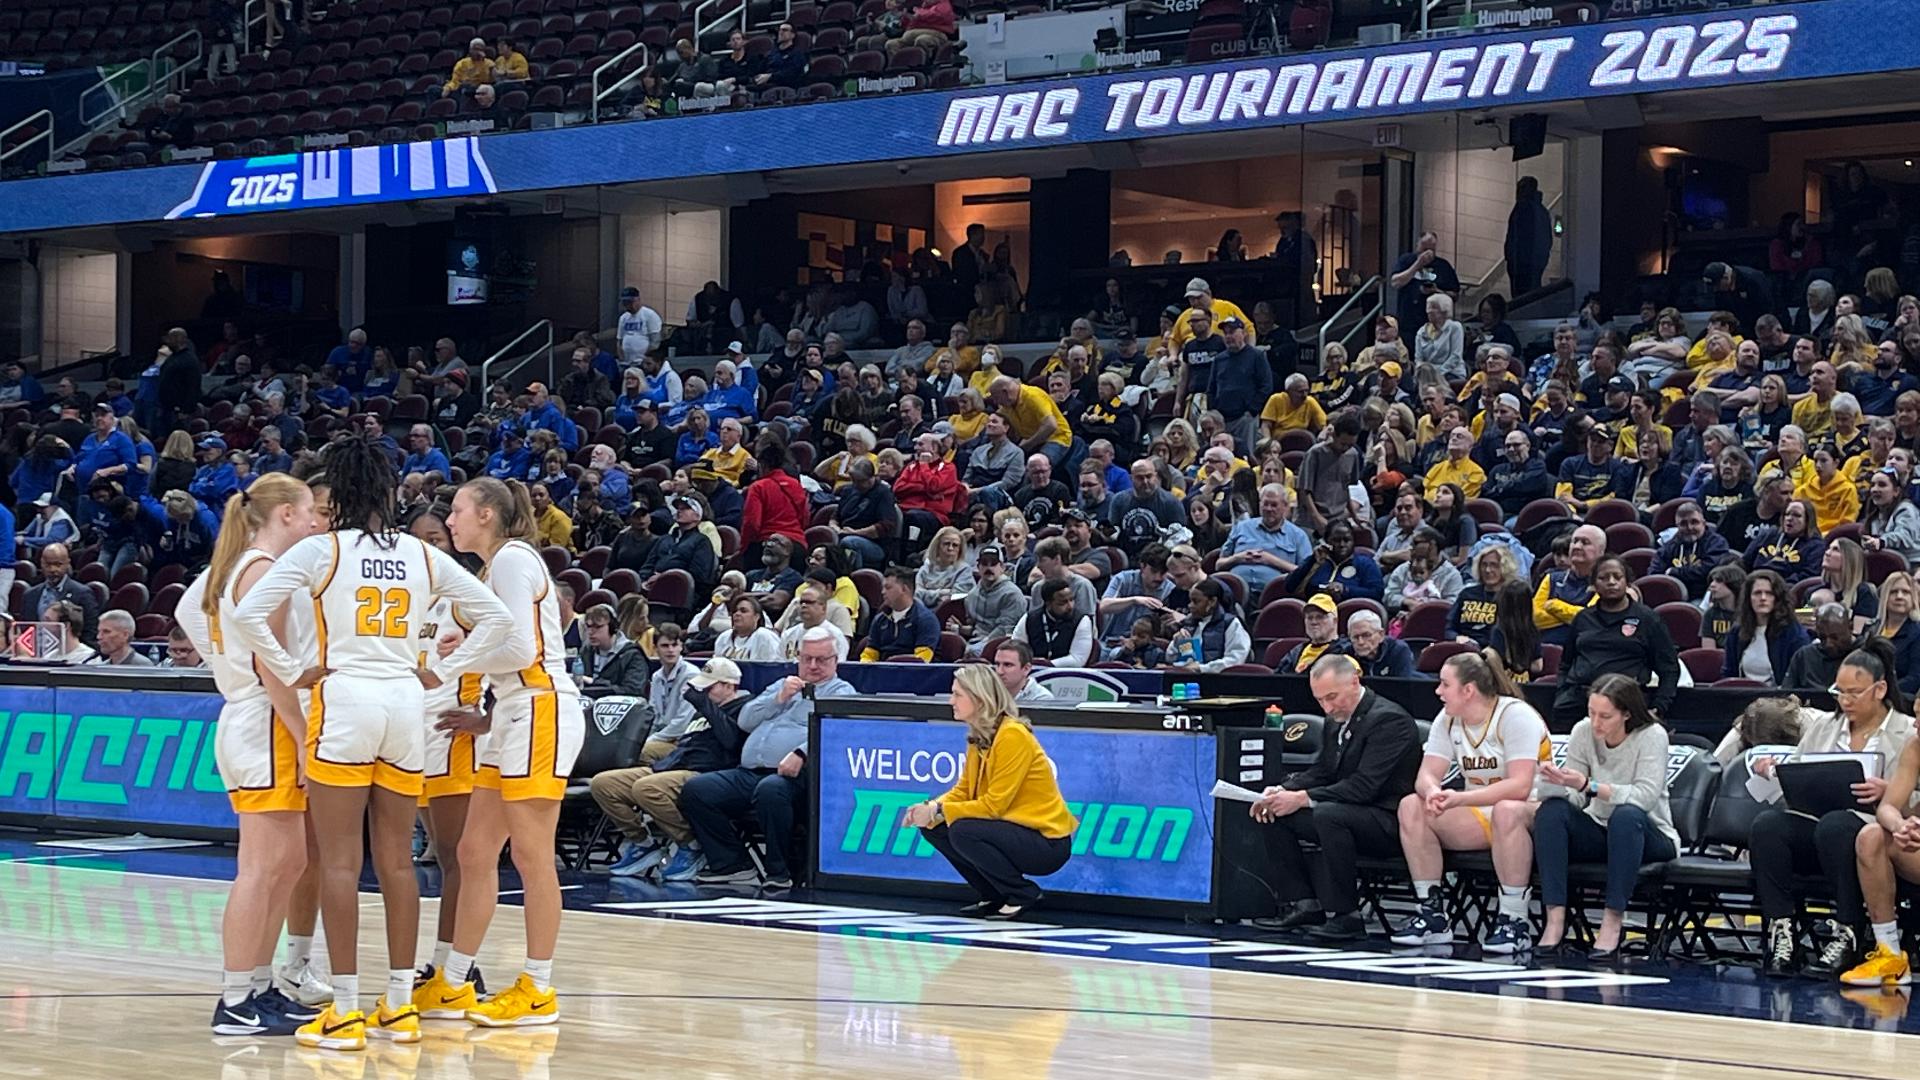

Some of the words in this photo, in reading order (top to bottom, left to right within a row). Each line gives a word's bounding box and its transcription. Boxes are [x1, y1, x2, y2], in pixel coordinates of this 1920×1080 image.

[1477, 7, 1553, 26] Huntington
[1098, 48, 1161, 69] Huntington
[1211, 40, 1247, 55] CLUB
[937, 88, 1081, 147] MAC
[1105, 36, 1574, 133] TOURNAMENT
[1589, 15, 1797, 88] 2025
[227, 173, 297, 207] 2025
[361, 558, 406, 580] GOSS
[355, 586, 411, 638] 22
[1461, 600, 1497, 612] TOLED
[598, 703, 628, 715] MAC
[847, 747, 967, 784] WELCO
[840, 788, 1194, 863] MION
